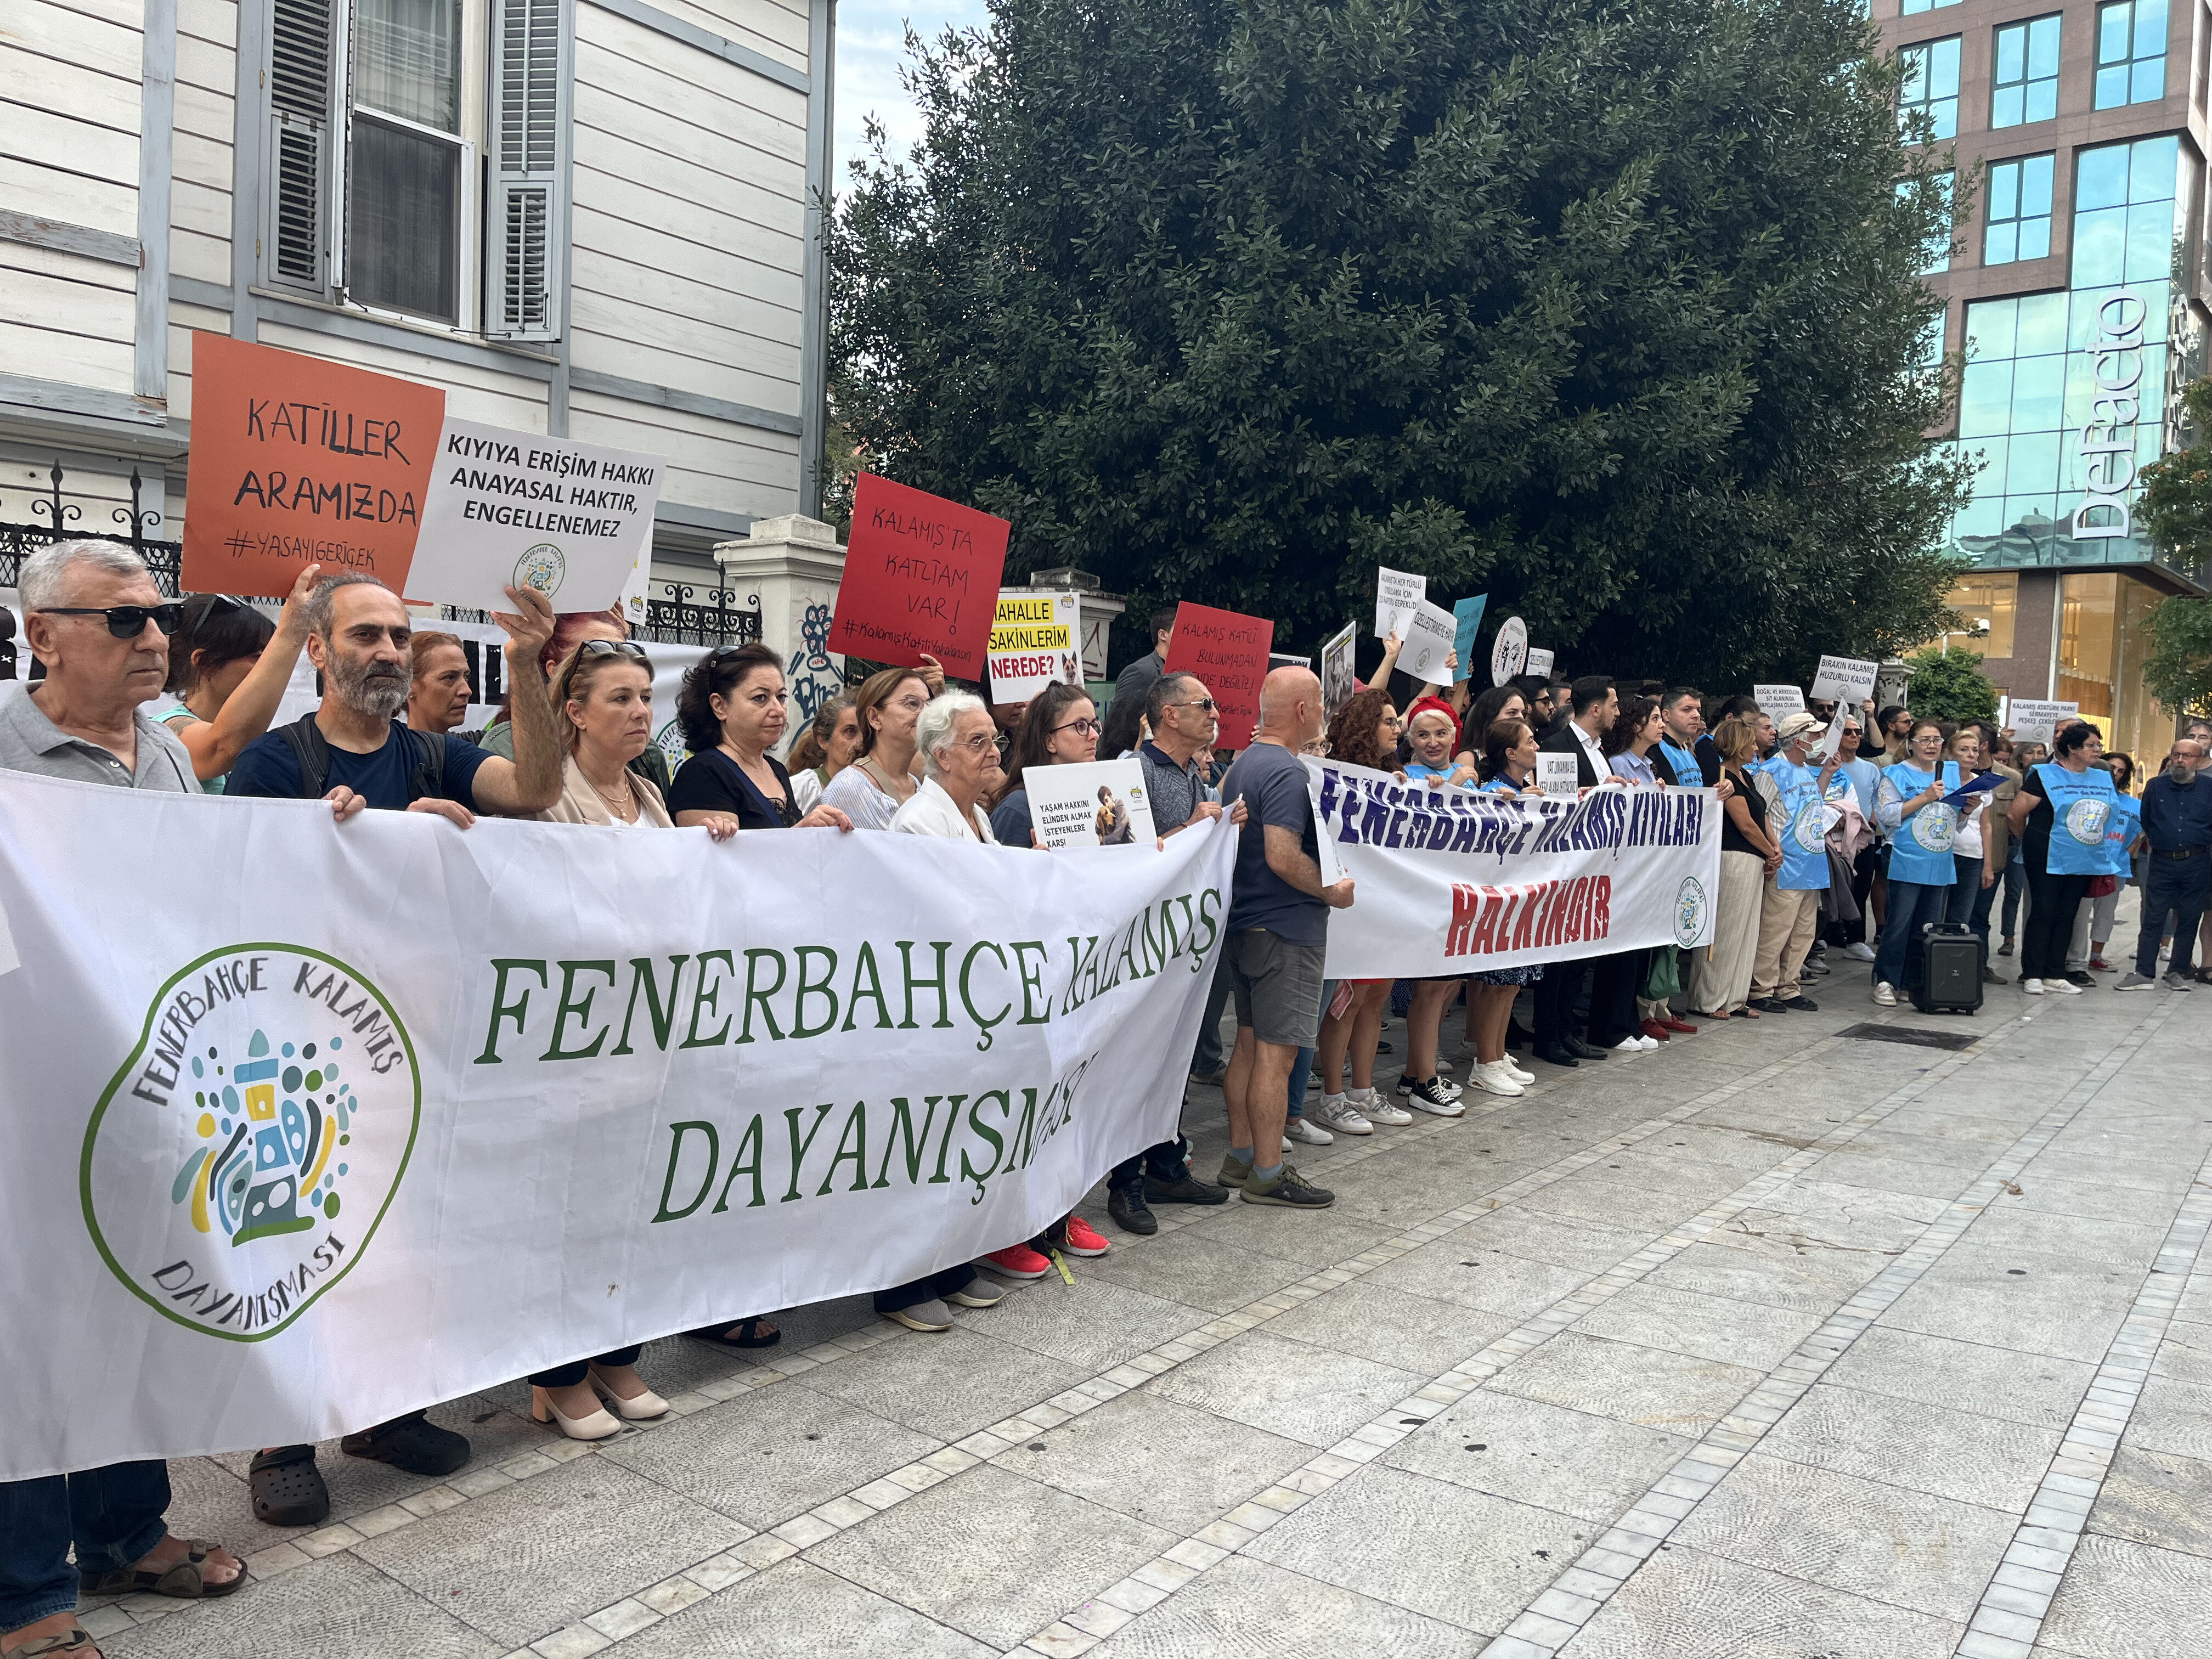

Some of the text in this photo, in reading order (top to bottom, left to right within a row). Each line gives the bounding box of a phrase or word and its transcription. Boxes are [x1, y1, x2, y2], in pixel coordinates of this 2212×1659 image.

[247, 398, 410, 465] KATİLLER
[2072, 289, 2146, 540] DeFacto
[448, 434, 654, 485] KIYIYA ERİŞİM HAKKI
[234, 470, 416, 528] ARAMIZDA
[450, 467, 637, 515] ANAYASAL HAKTIR,
[464, 500, 620, 537] ENGELLENEMEZ
[989, 627, 1067, 650] SAKİNLERİM
[1182, 623, 1226, 645] KALAMIŞ
[991, 656, 1054, 679] NEREDE?
[1197, 648, 1259, 669] BULUNMADAN
[1821, 659, 1875, 675] BIRAKIN KALAMIŞ
[1819, 670, 1872, 685] HUZURLU KALSIN
[1040, 800, 1089, 814] YAŞAM HAKKINI
[1042, 811, 1092, 825] ELİNDEN ALMAK
[1627, 792, 1704, 847] KIYILARI
[1045, 823, 1086, 837] İSTEYENLERE
[1047, 838, 1066, 848] KARŞI
[1444, 875, 1612, 957] HALKINDIR
[473, 887, 1222, 1065] FENERBAHÇE KALAMIŞ
[132, 957, 404, 1107] FENERBAHÇE KALAMIŞ
[151, 1232, 346, 1330] DAYANIŞMASI
